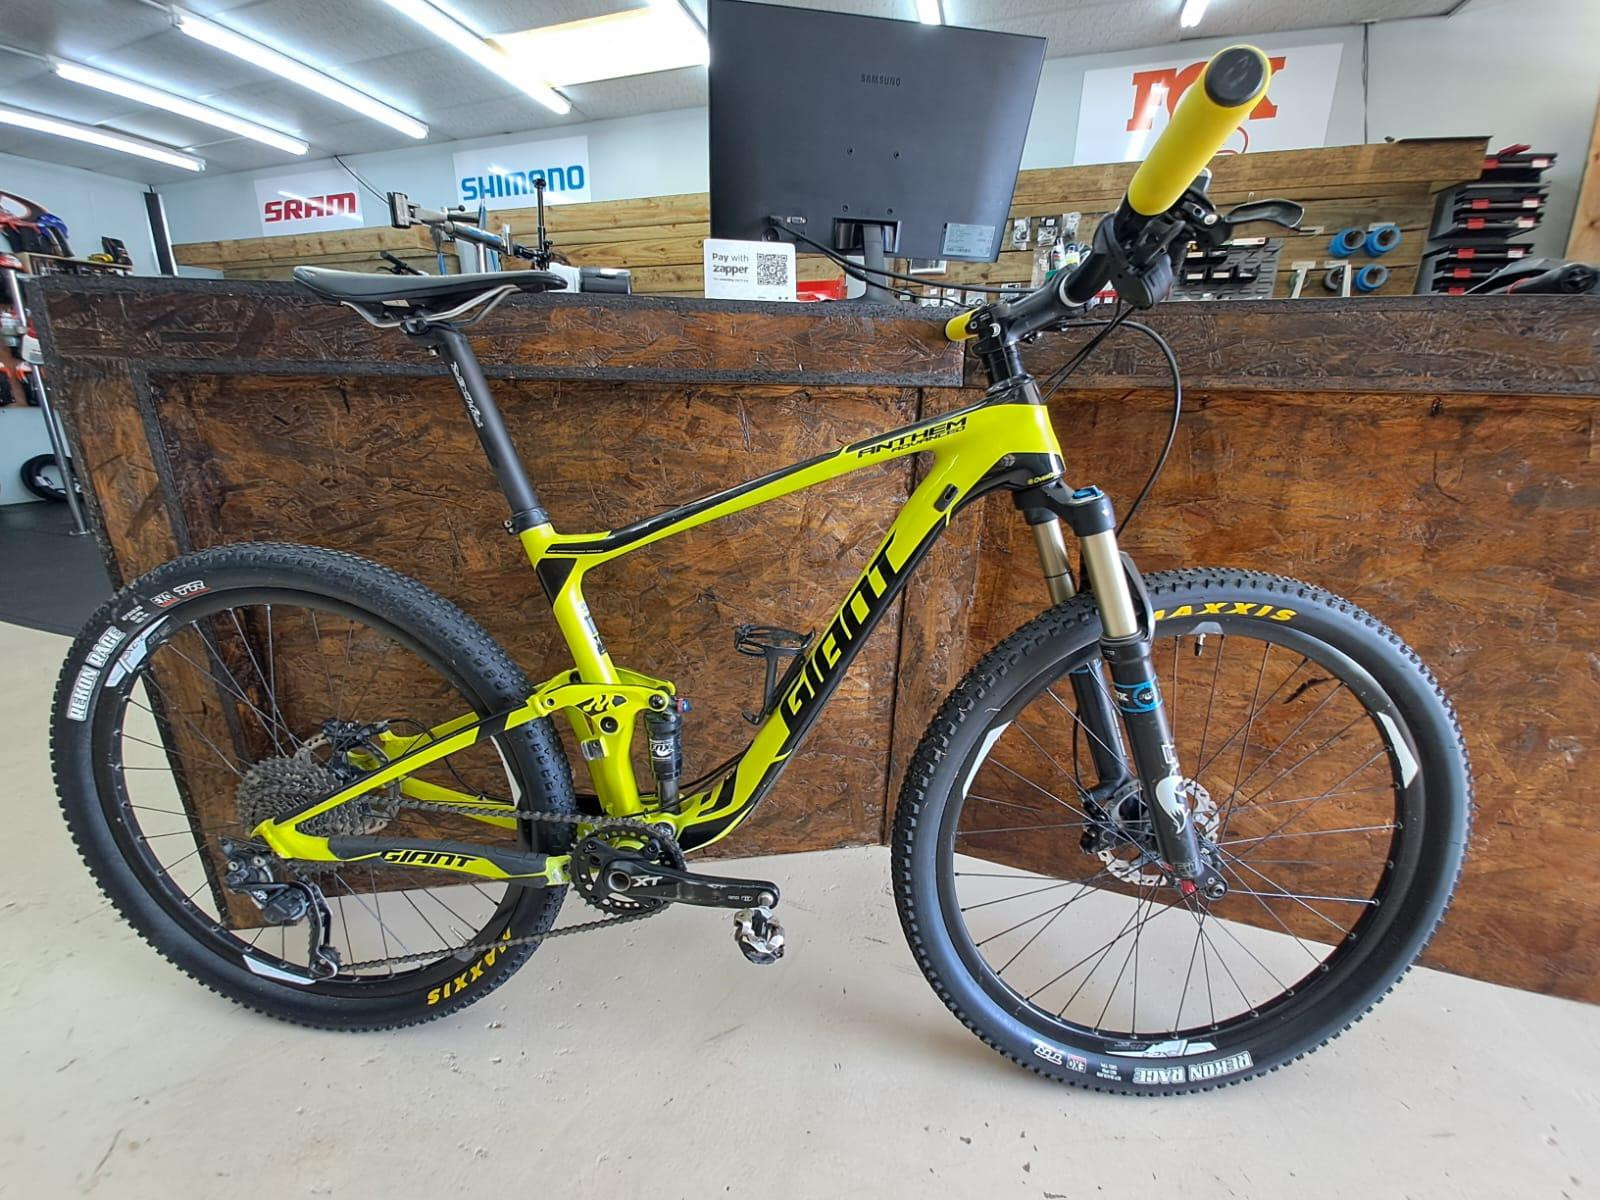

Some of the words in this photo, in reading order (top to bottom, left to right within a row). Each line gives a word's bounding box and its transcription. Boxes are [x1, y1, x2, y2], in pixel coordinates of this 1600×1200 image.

[860, 73, 902, 87] SAMSUNG
[461, 164, 585, 201] SHIMANO
[264, 191, 356, 223] SRAM
[712, 252, 729, 263] Pay
[731, 253, 749, 263] with
[713, 264, 749, 276] zapper
[857, 416, 967, 459] ANTHEM
[66, 664, 101, 722] REKON
[85, 625, 127, 668] RACE
[379, 849, 479, 868] GIANT
[631, 875, 663, 888] XT
[1132, 1065, 1187, 1085] RACE
[1188, 1050, 1254, 1081] REKON
